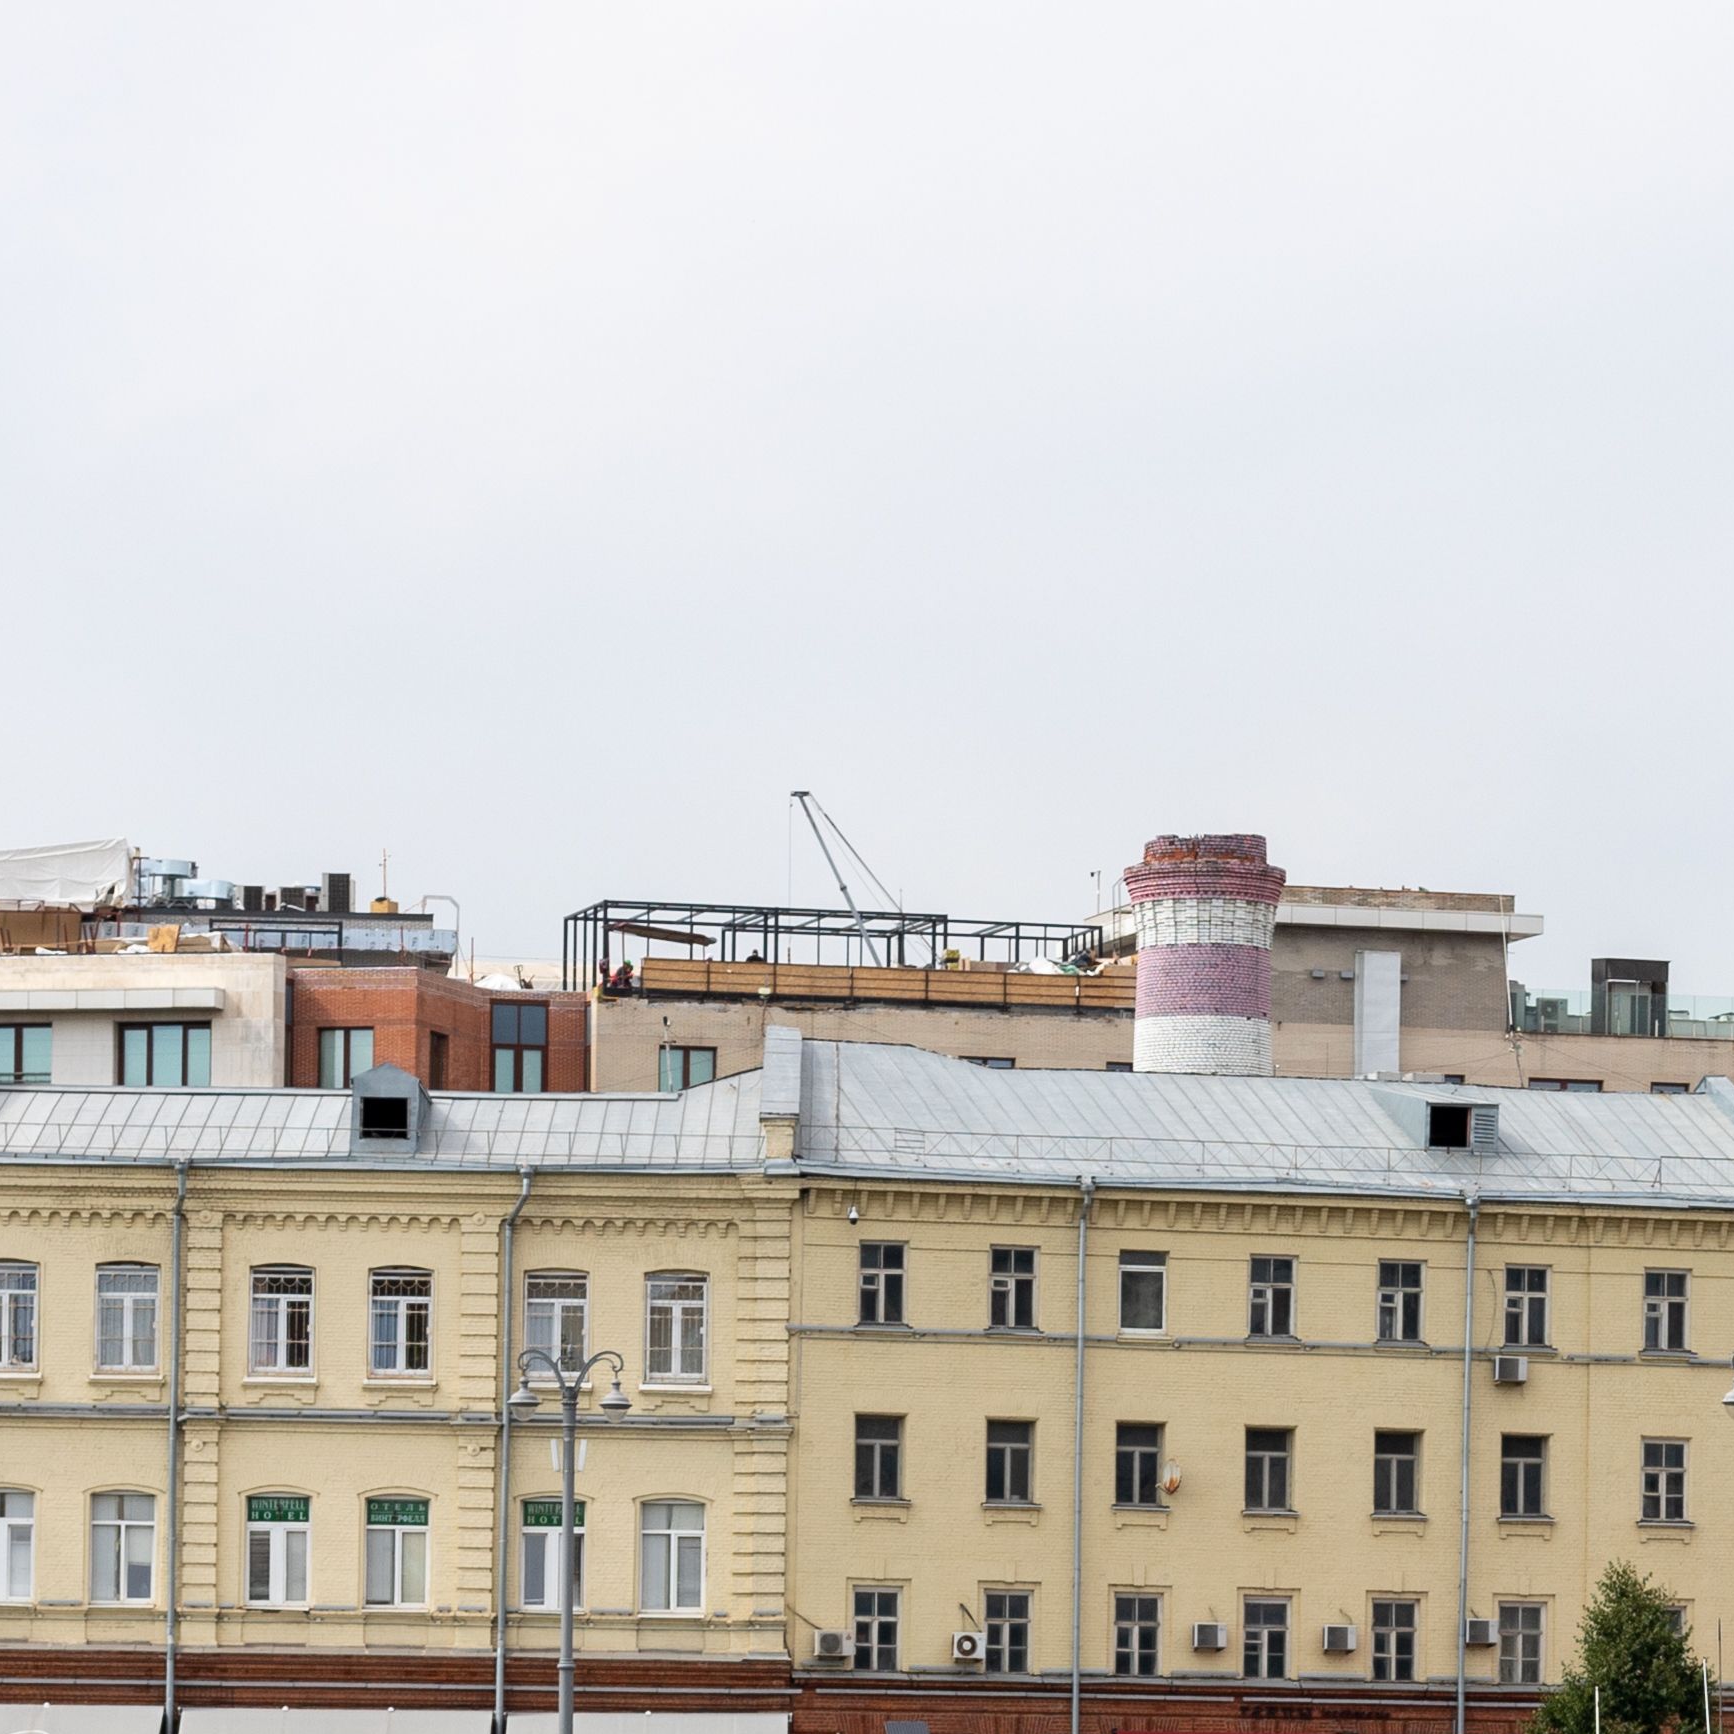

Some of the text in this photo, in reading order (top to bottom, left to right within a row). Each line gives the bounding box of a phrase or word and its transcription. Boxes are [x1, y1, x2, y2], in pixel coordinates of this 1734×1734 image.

[370, 1503, 426, 1511] ОТЕЛЬ
[251, 1511, 307, 1521] HOEL
[527, 1515, 582, 1525] HOTL
